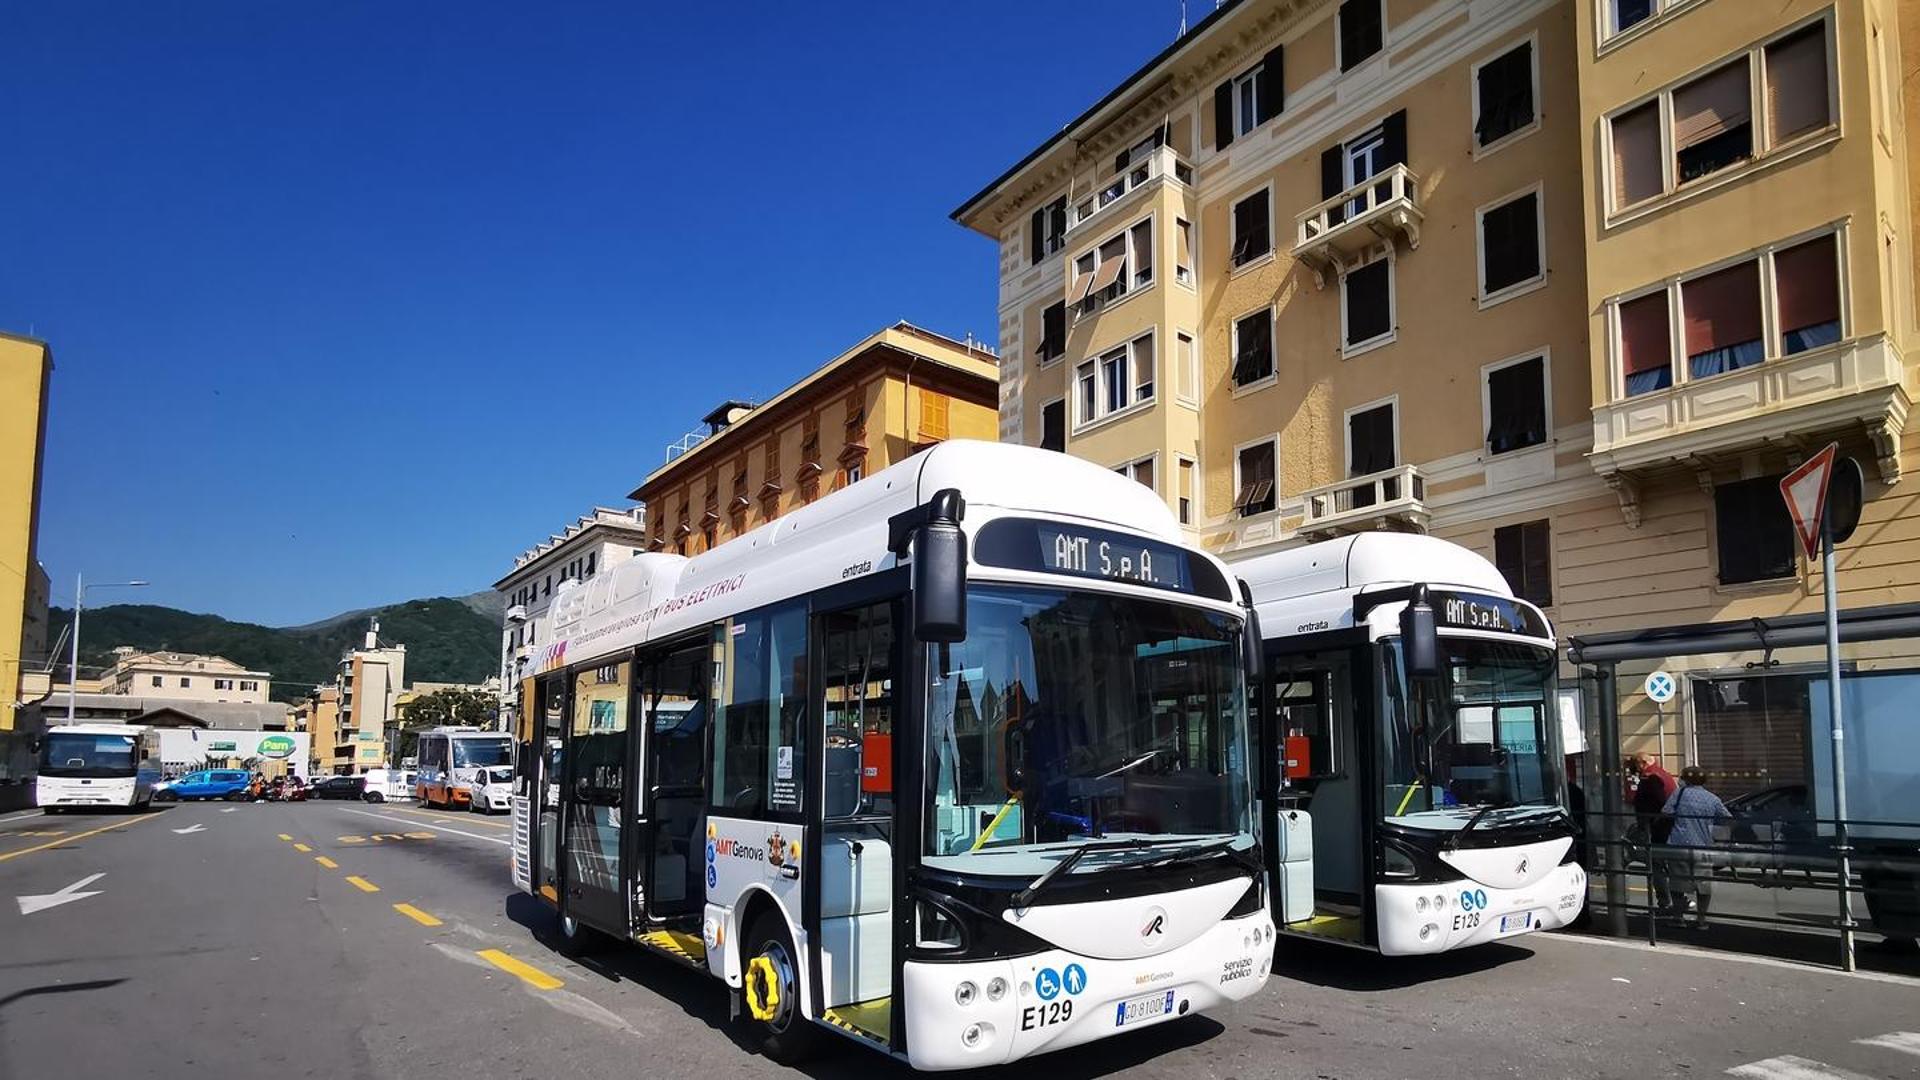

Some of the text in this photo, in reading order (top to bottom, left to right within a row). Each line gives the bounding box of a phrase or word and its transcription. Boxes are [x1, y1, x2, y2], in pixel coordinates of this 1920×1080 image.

[1056, 533, 1159, 582] AMT S.p.A.
[842, 560, 872, 578] entrata
[1446, 598, 1465, 624] AMT
[1297, 620, 1329, 633] entrata
[263, 740, 289, 750] Pam
[1453, 912, 1480, 931] E128
[1224, 958, 1252, 971] servizio
[1022, 1000, 1073, 1031] E129
